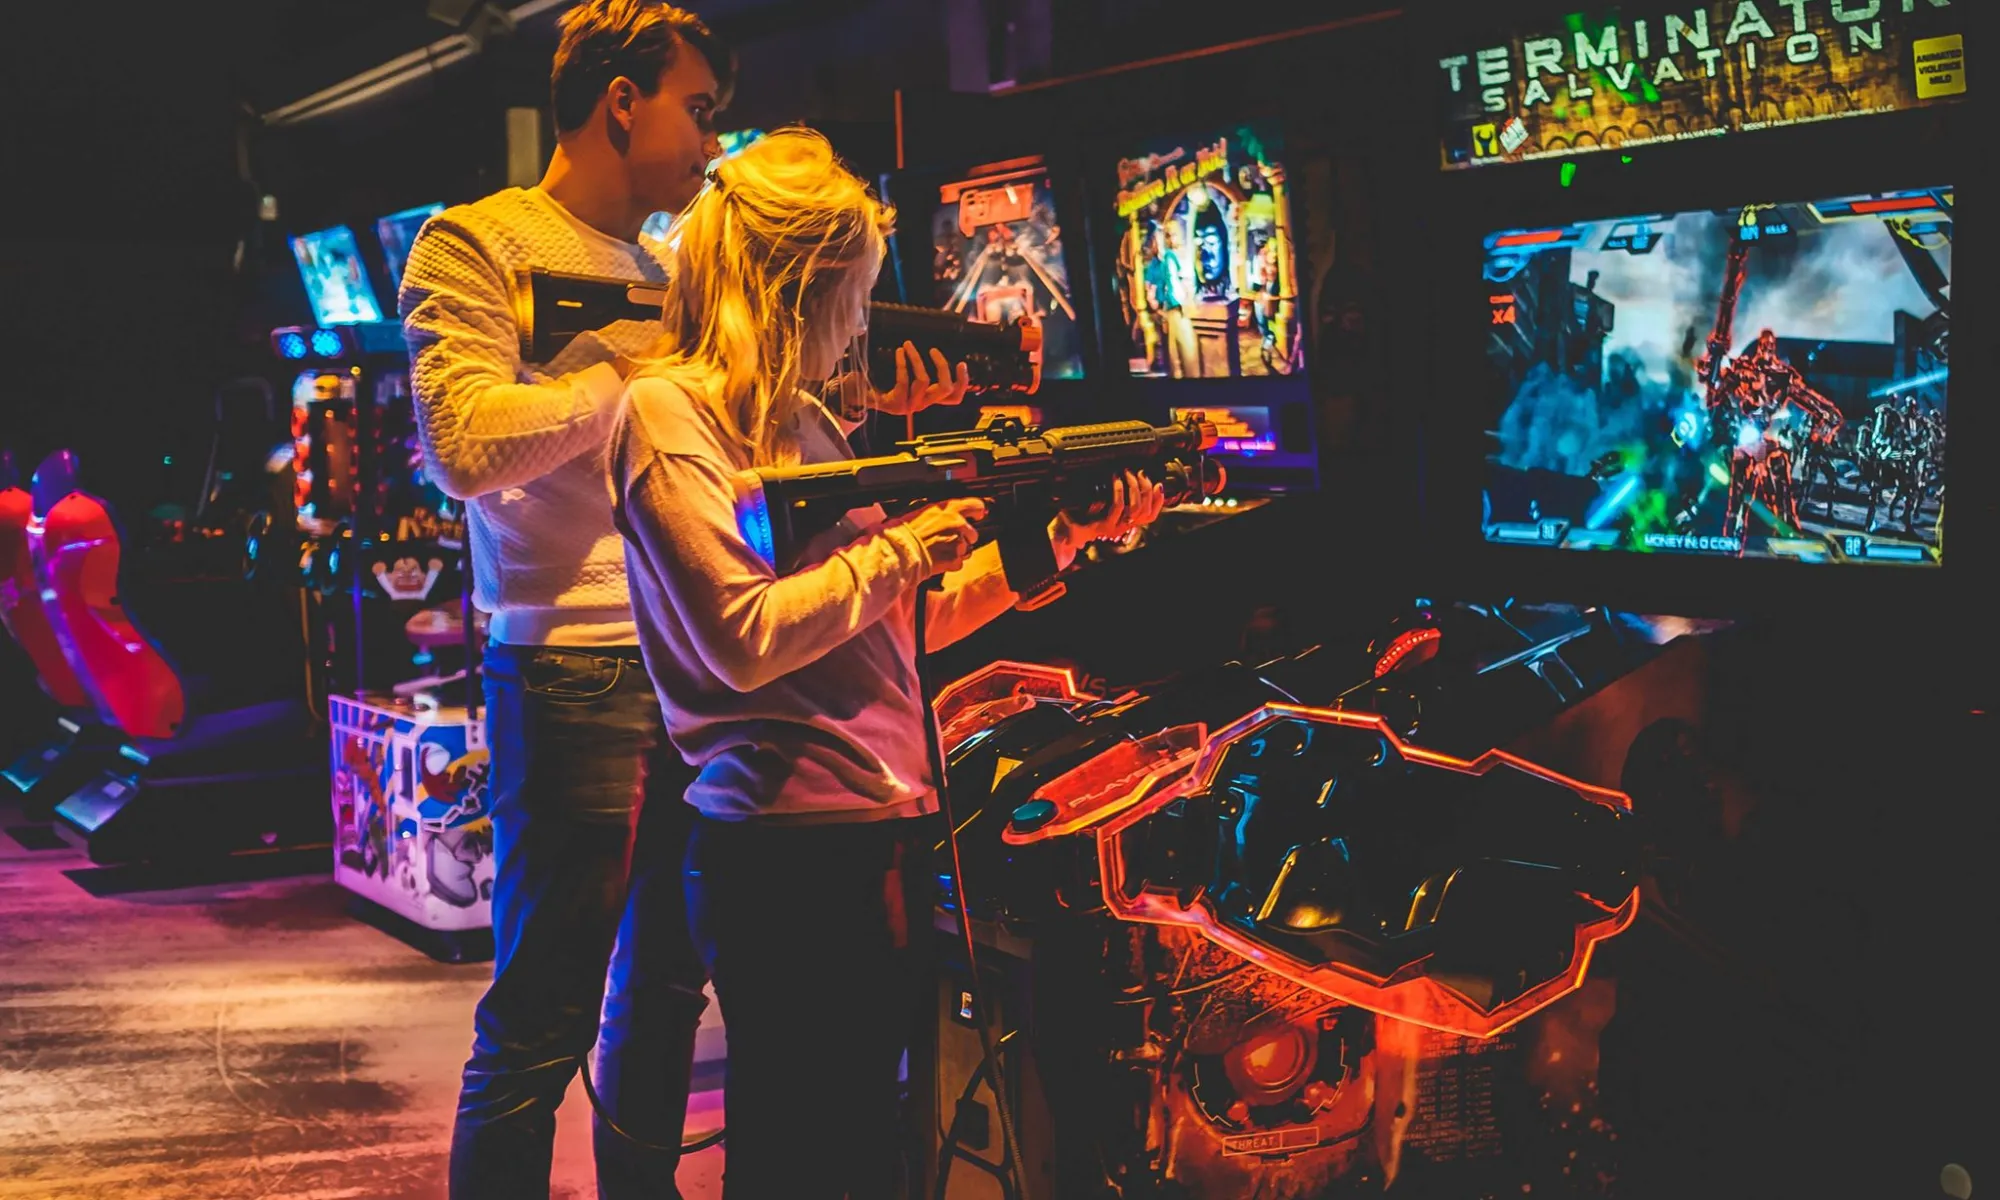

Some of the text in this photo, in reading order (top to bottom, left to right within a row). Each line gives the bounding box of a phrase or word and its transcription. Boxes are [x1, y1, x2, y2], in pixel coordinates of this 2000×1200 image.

[1482, 22, 1883, 112] SALVATION
[1644, 533, 1684, 548] MONEY
[1232, 1136, 1275, 1150] THREAT
